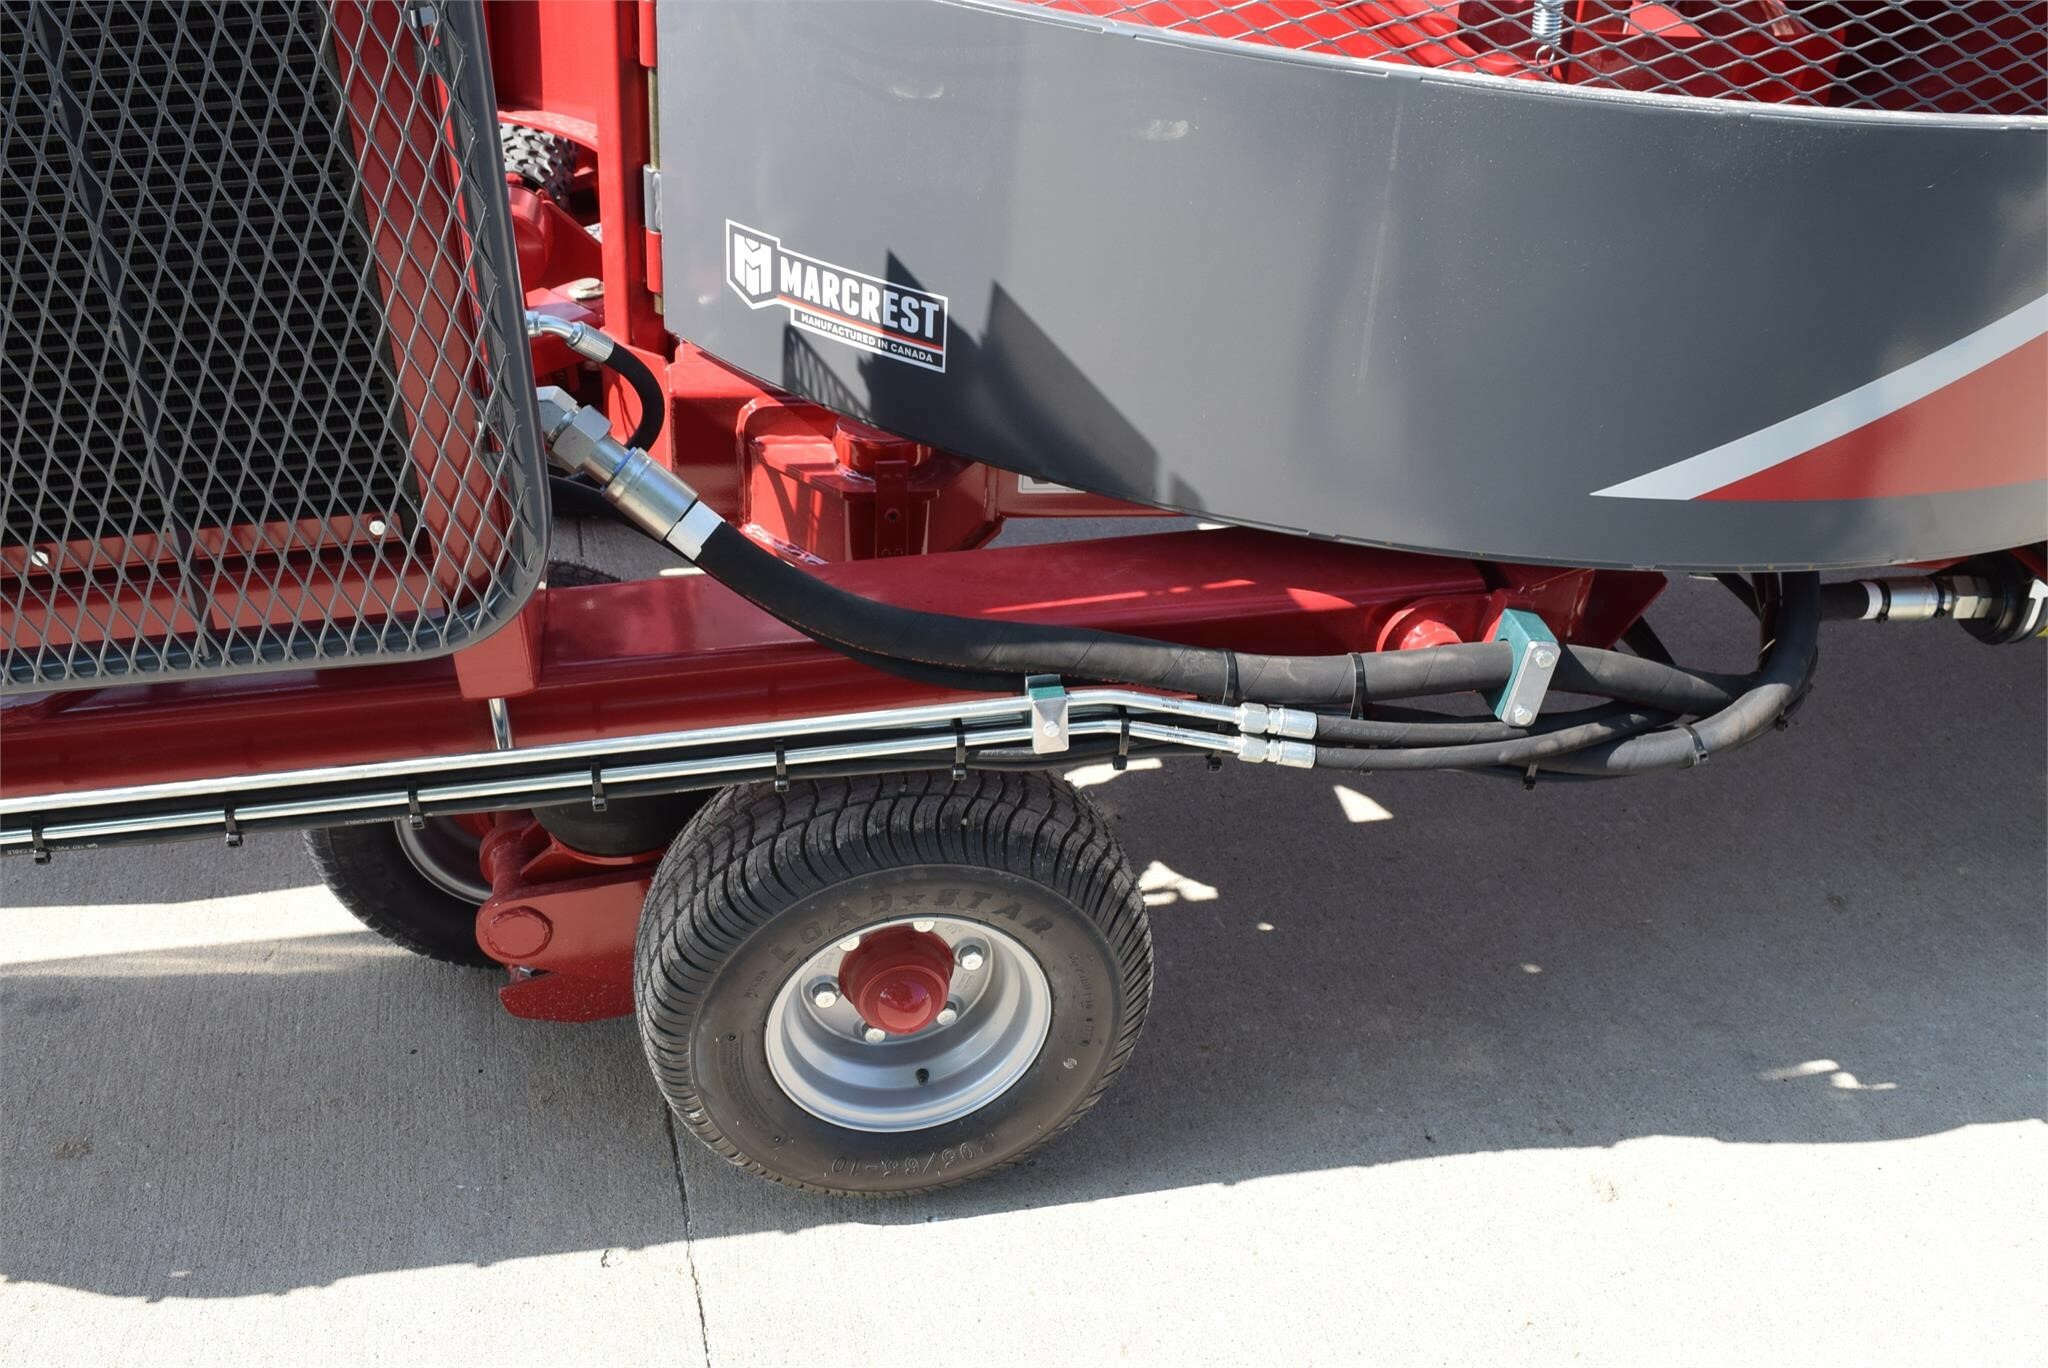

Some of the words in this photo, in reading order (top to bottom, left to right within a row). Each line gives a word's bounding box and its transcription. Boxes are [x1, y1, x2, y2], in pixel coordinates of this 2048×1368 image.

[780, 255, 940, 339] MARCREST
[801, 312, 876, 346] MANUFACTURED
[877, 337, 889, 351] IN
[890, 344, 933, 363] CANADA
